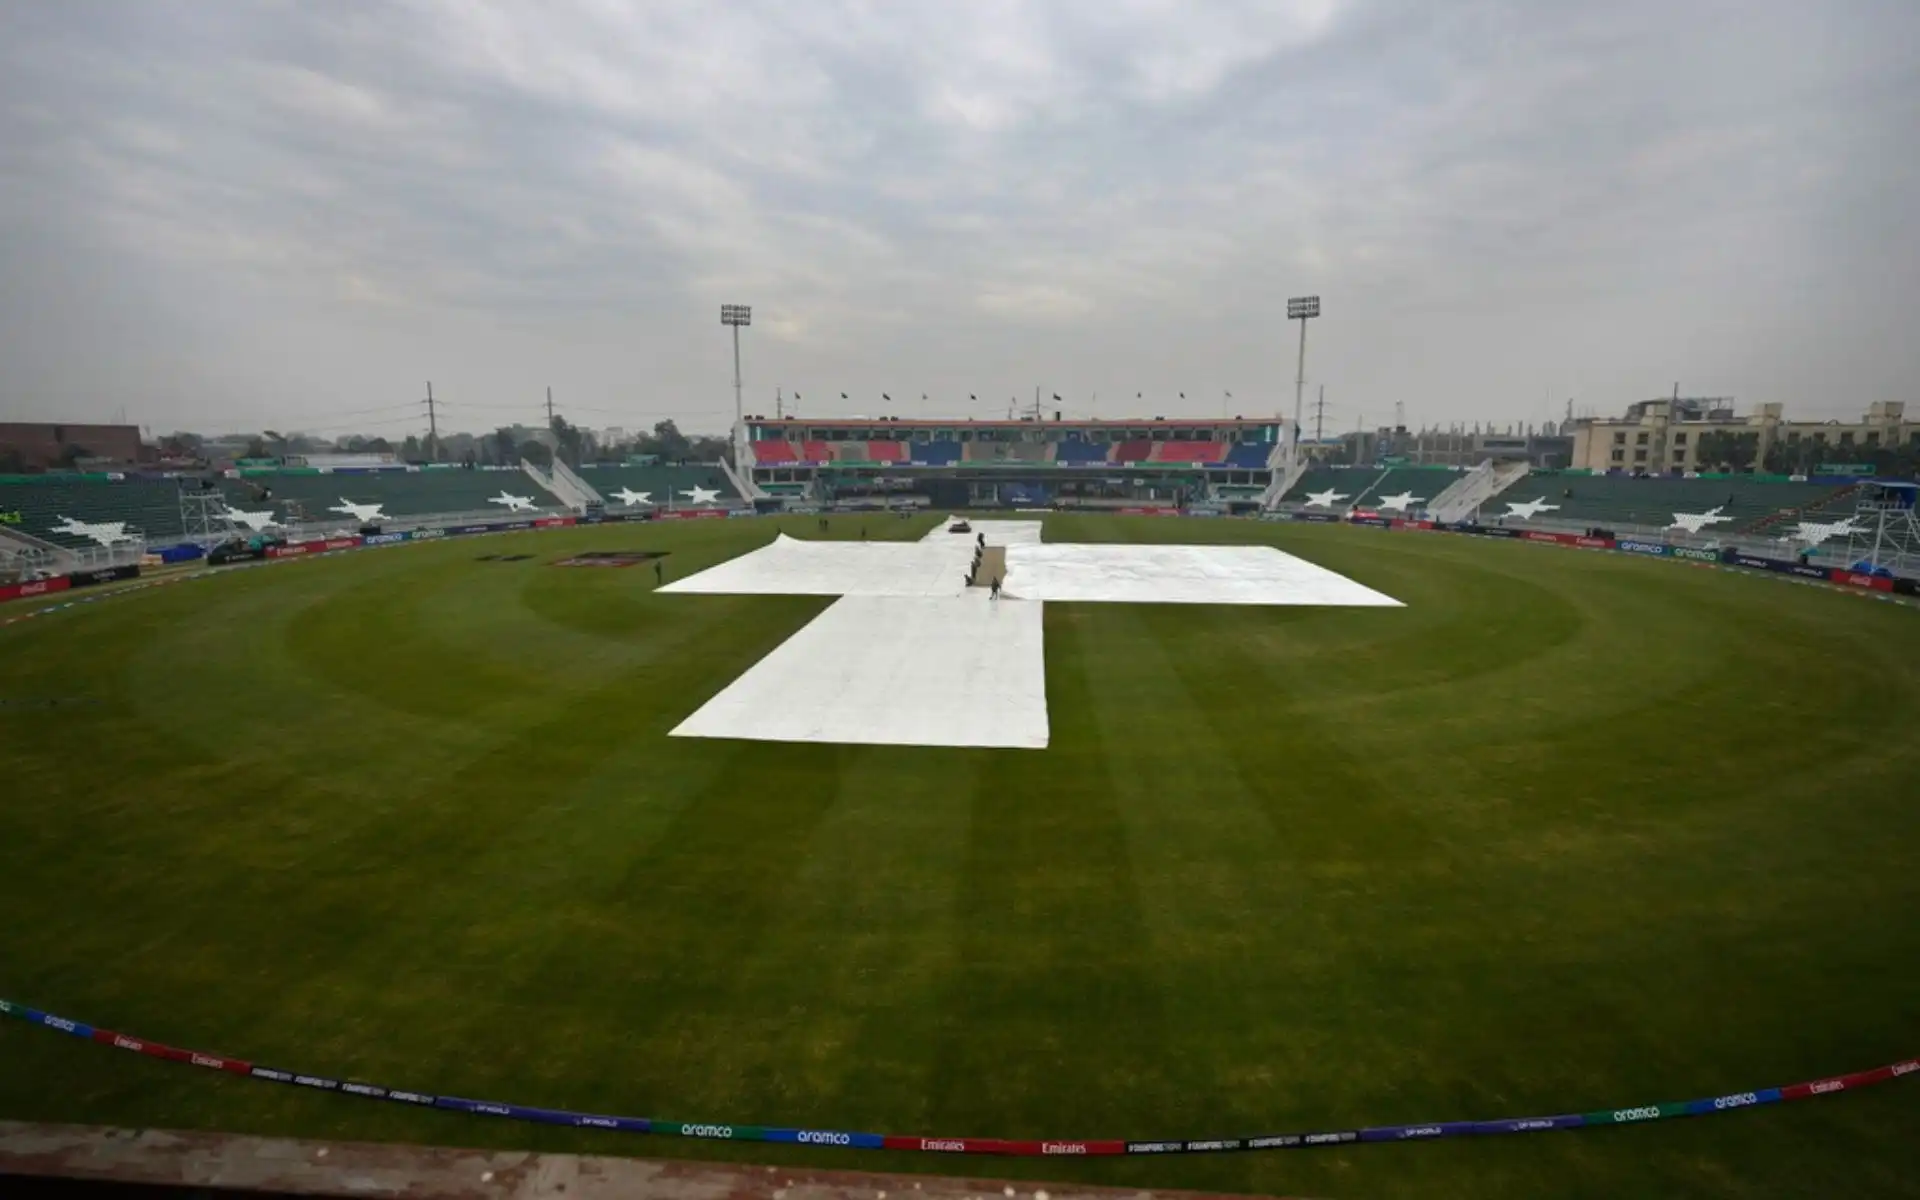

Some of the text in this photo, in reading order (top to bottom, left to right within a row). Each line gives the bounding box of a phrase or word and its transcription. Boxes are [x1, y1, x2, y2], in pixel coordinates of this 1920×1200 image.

[1620, 541, 1662, 554] aramco
[1613, 1106, 1660, 1122] aramco
[681, 1124, 732, 1138] aramco
[797, 1131, 850, 1145] aramco
[921, 1139, 965, 1152] Emirates
[1041, 1142, 1087, 1155] Emirates
